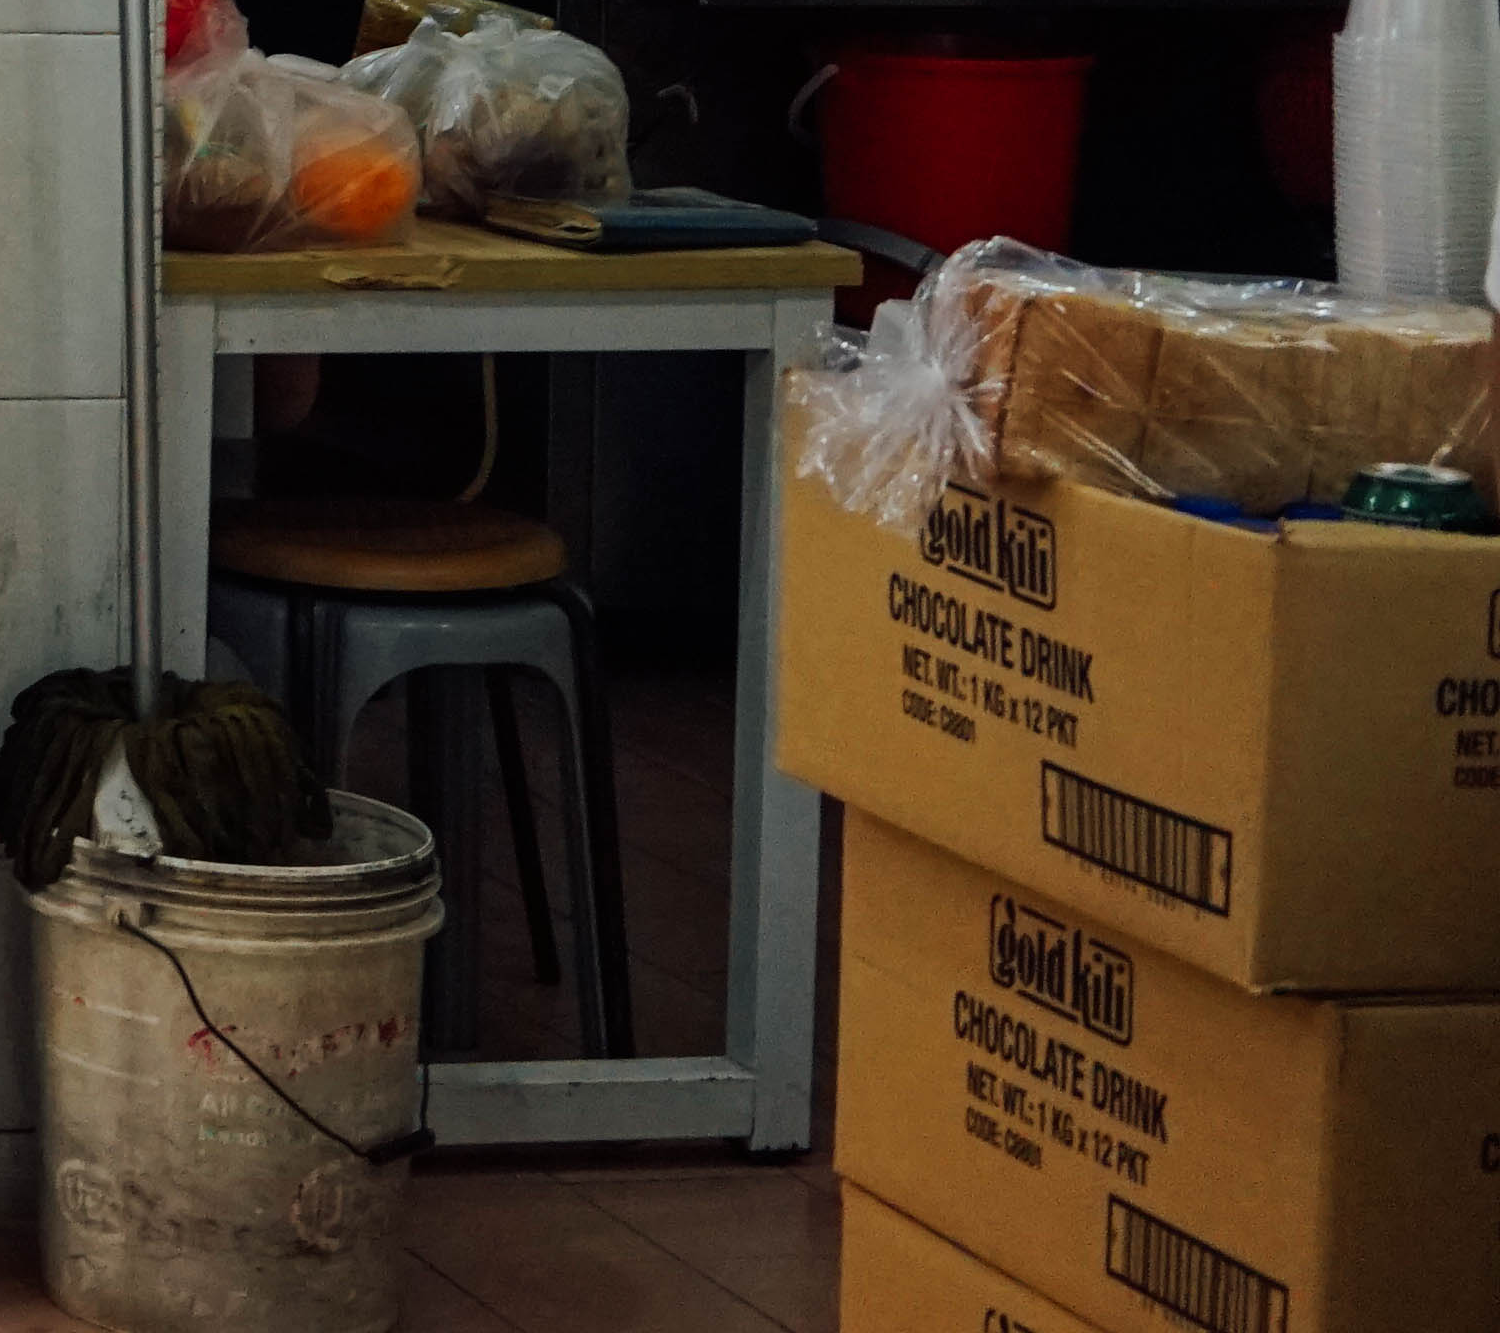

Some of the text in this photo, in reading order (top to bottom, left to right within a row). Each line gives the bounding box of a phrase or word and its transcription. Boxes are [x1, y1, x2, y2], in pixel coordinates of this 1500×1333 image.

[926, 500, 1050, 596] gold kili
[888, 573, 1095, 704] CHOCOLATE DRINK
[904, 644, 1079, 749] NET. KG 12 PKT
[997, 920, 1126, 1032] gold kili
[955, 990, 1168, 1144] CHOCOLATE DRINK
[967, 1061, 1150, 1186] NET. KG 12 PKT
